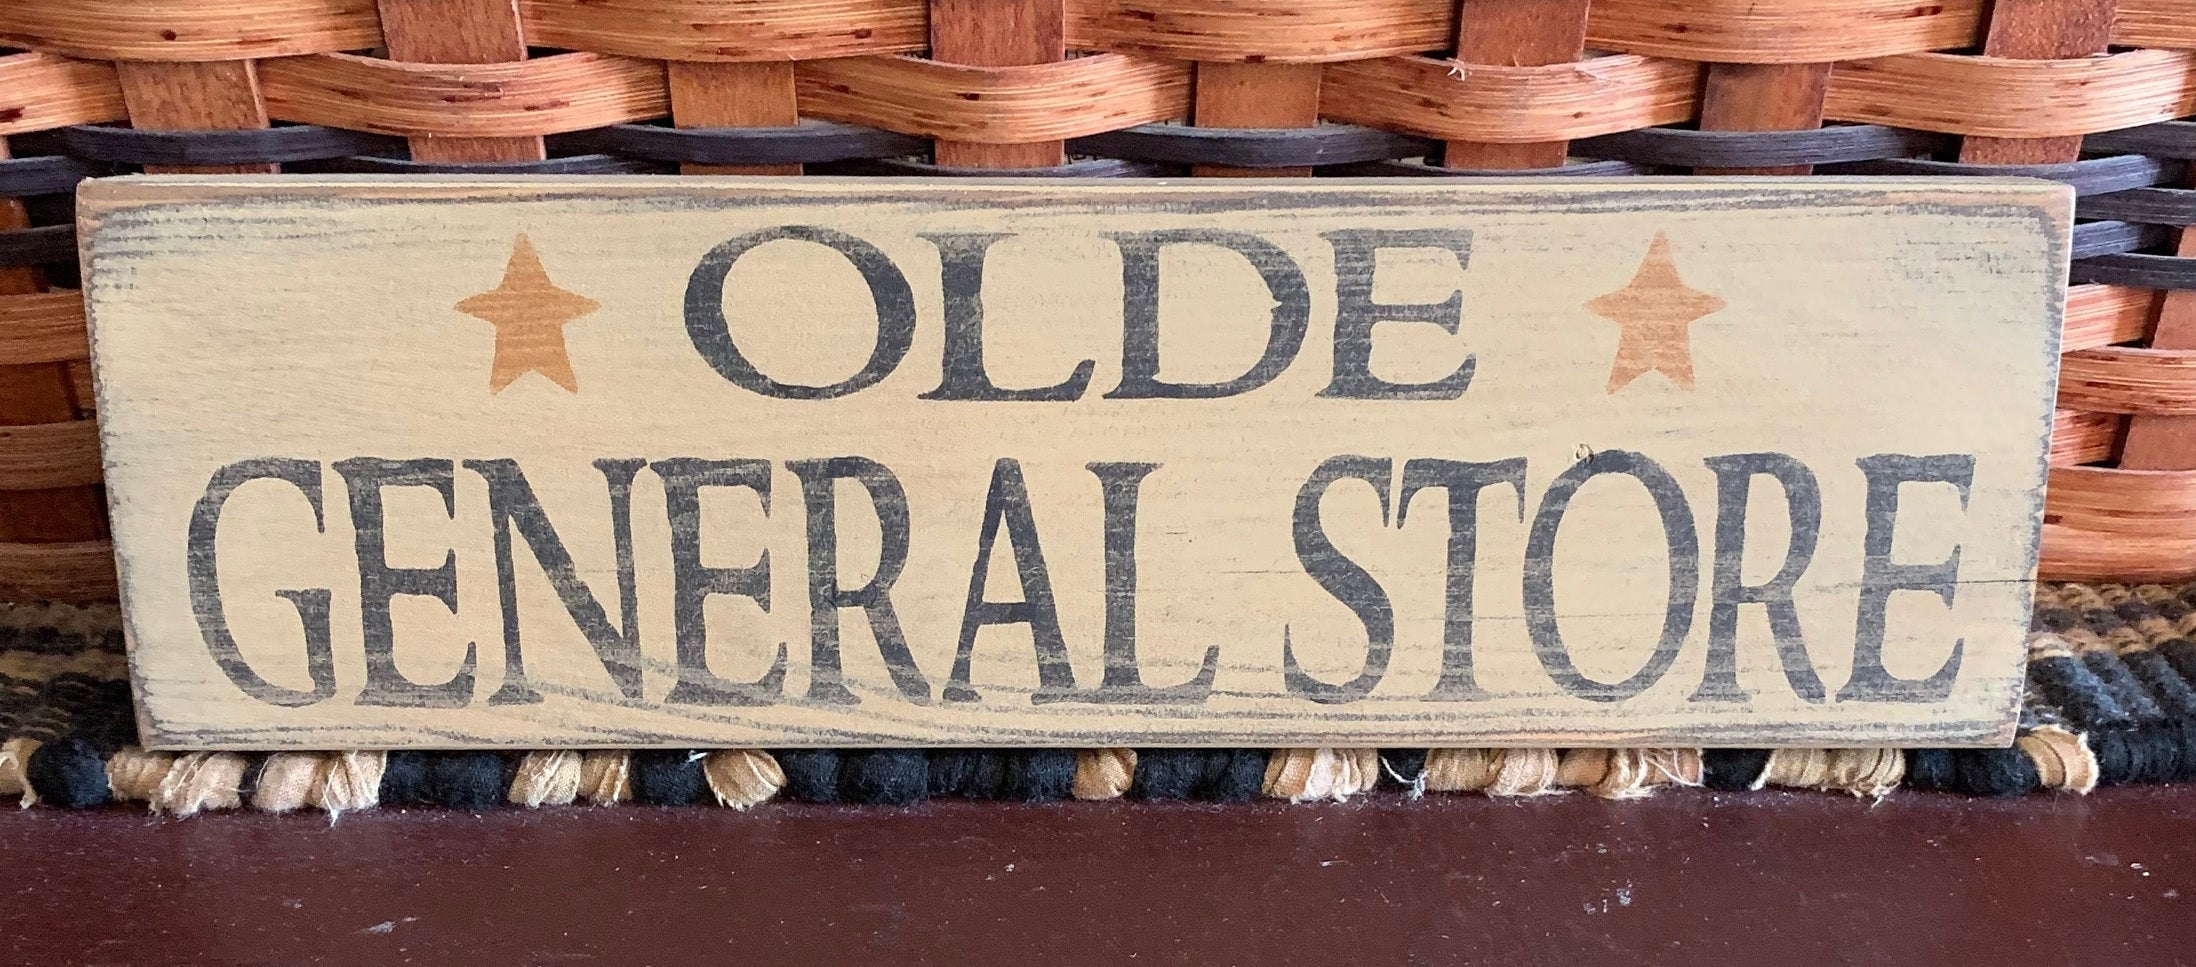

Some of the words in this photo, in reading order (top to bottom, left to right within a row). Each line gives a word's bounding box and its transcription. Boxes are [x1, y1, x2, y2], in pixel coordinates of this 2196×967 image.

[683, 225, 1478, 402] OLDE
[187, 456, 1219, 709] GENERAL
[1284, 448, 1976, 704] STORE
